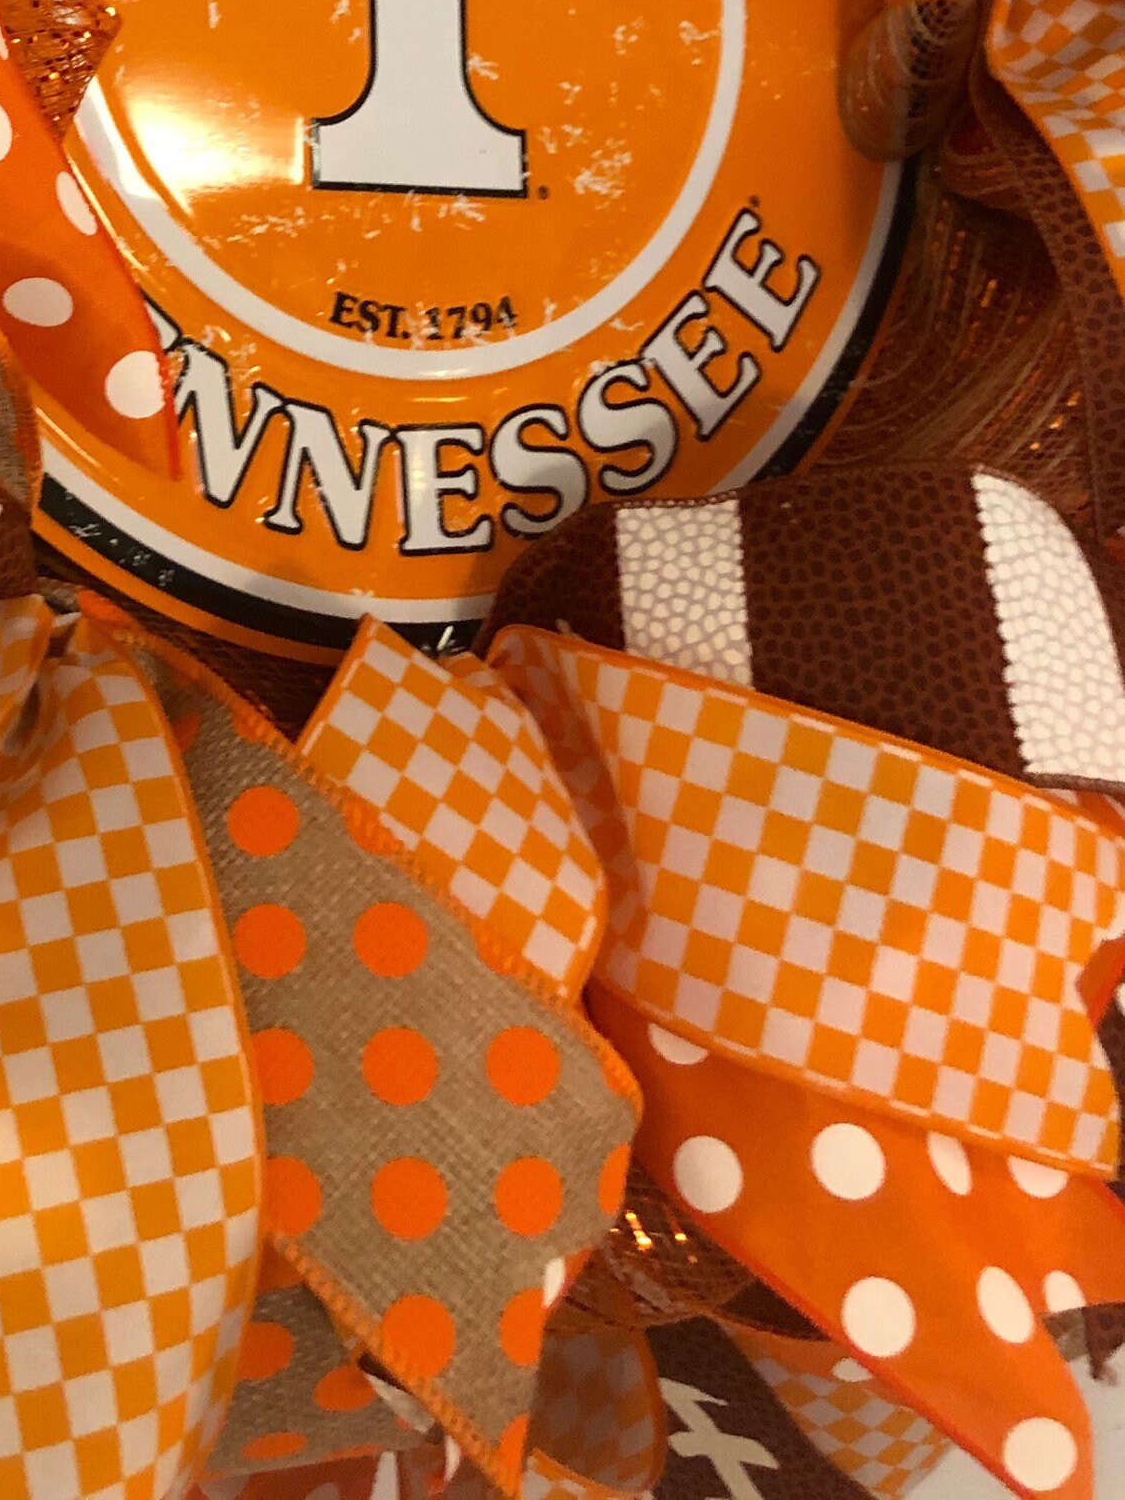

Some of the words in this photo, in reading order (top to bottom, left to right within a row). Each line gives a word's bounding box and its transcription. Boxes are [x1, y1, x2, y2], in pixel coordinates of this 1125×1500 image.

[139, 202, 822, 558] NNESSEE
[329, 290, 411, 340] EST.
[424, 295, 518, 341] 1794
